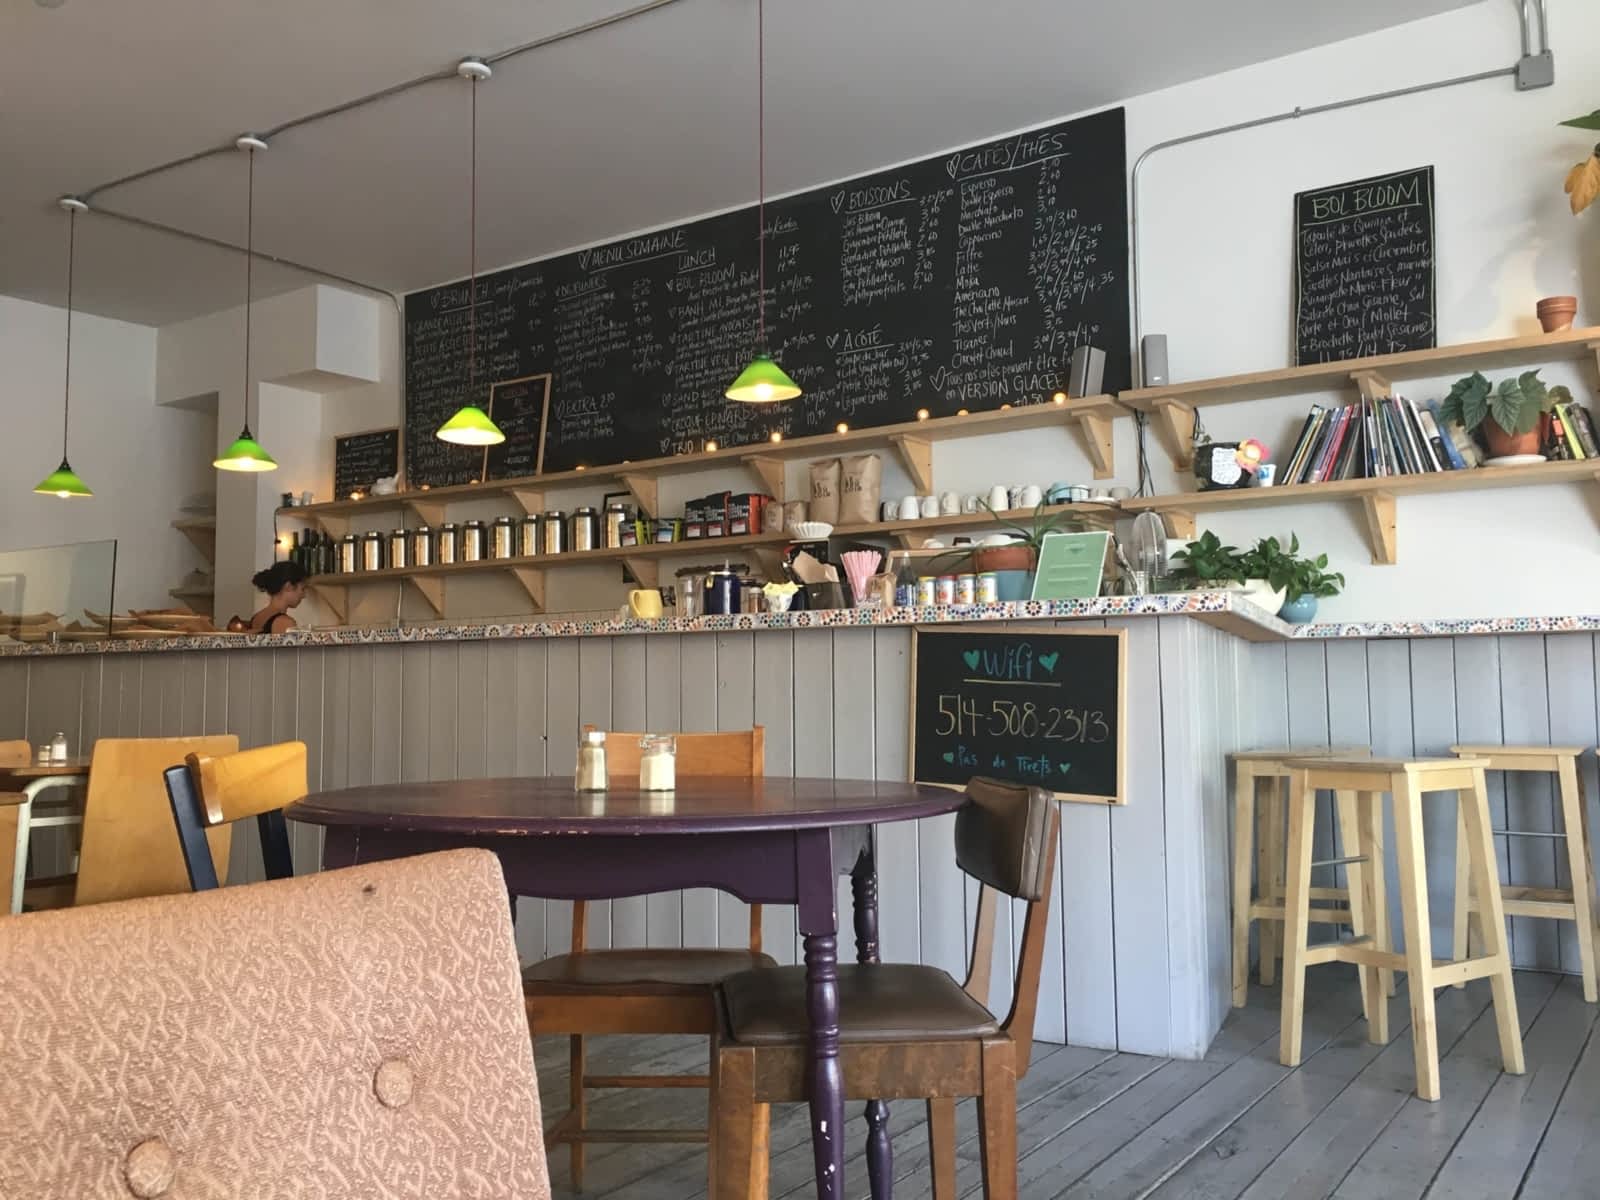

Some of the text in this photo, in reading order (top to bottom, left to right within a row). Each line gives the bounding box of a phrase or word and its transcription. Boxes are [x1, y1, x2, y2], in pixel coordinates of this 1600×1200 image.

[849, 179, 911, 210] BOISSONS
[1312, 175, 1420, 219] BOL BLOOM
[592, 230, 688, 267] MENU SEMAINE
[678, 246, 716, 271] LUNCH
[957, 379, 1009, 401] VERSION
[672, 438, 694, 455] TRIO
[983, 642, 1033, 681] Wifi
[935, 693, 1110, 744] 514-508-2313
[957, 745, 978, 769] Pas
